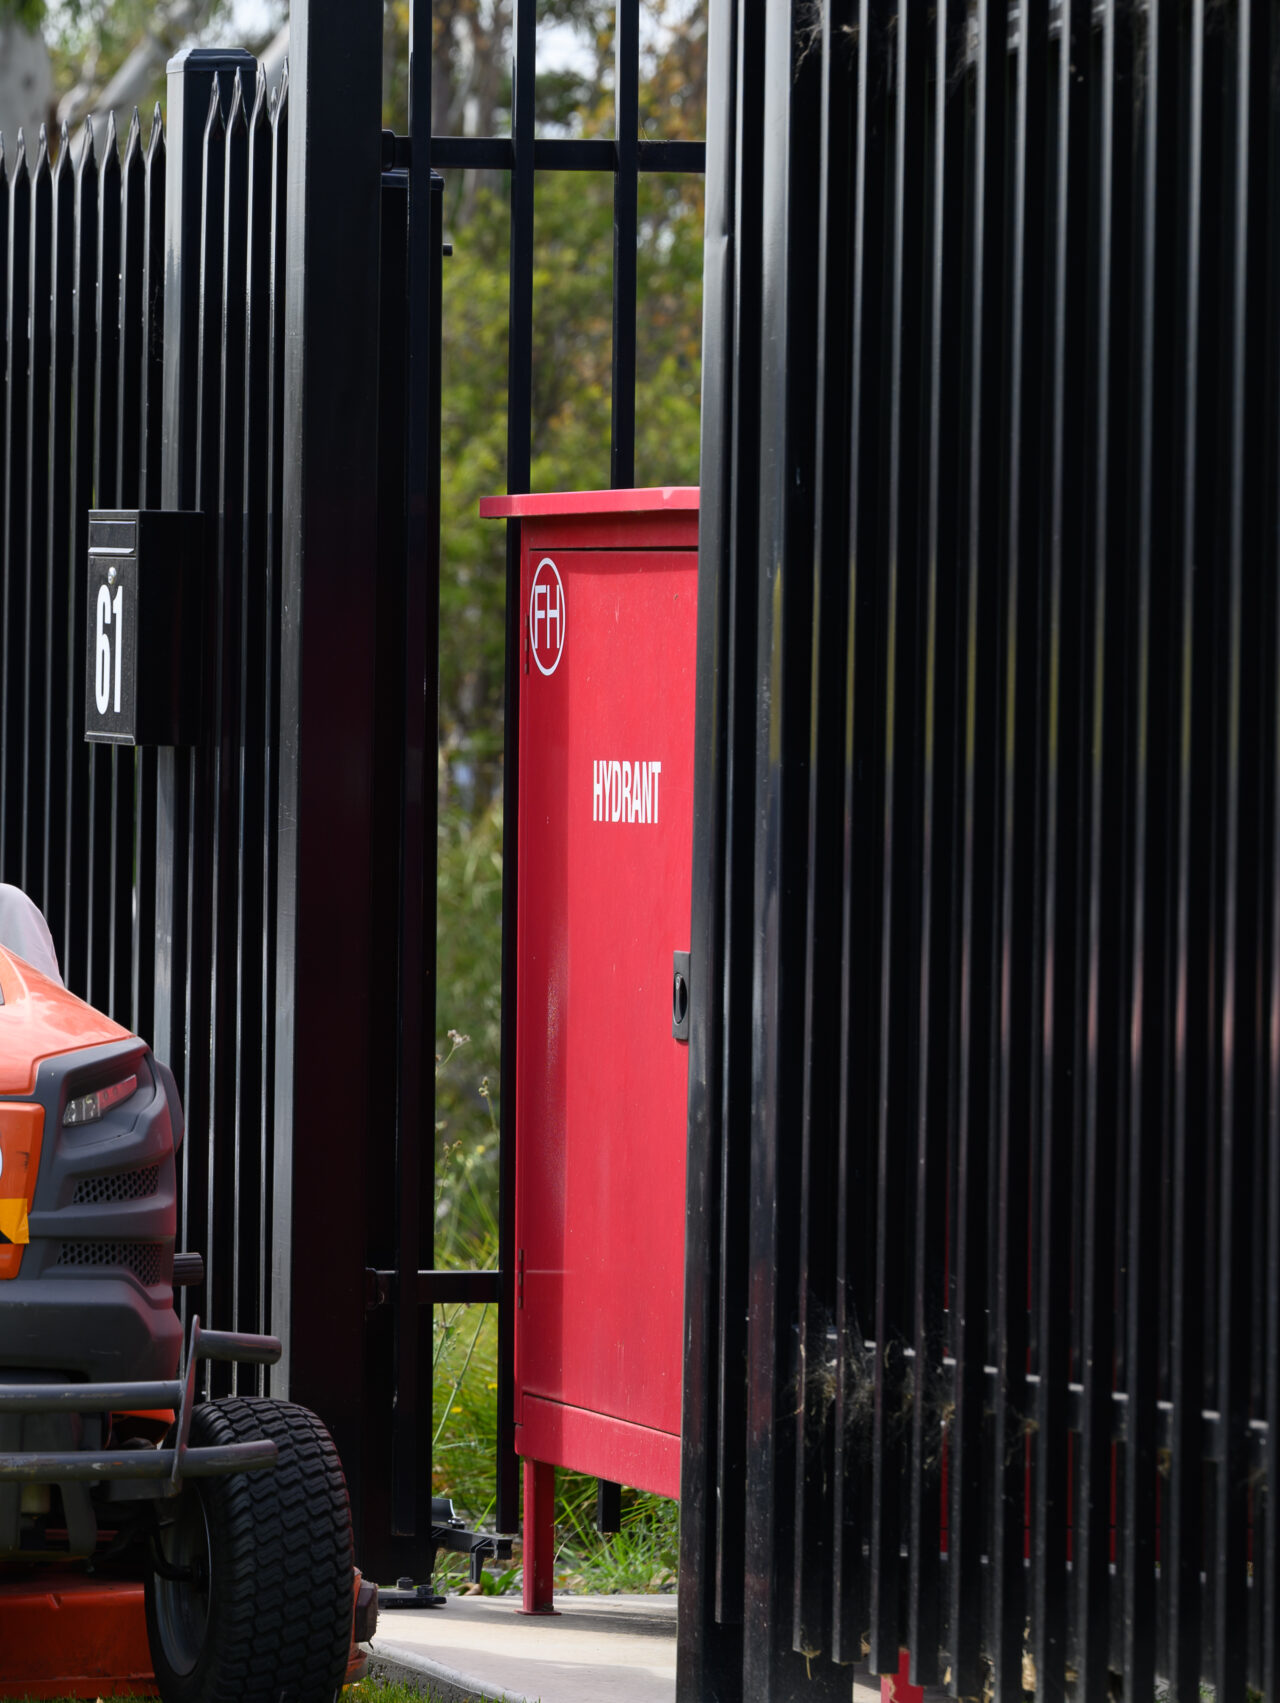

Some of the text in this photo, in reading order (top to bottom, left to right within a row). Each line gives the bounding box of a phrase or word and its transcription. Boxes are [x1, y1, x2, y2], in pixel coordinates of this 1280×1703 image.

[95, 584, 123, 715] 61
[534, 584, 560, 650] FH
[593, 760, 661, 824] HYDRANT
